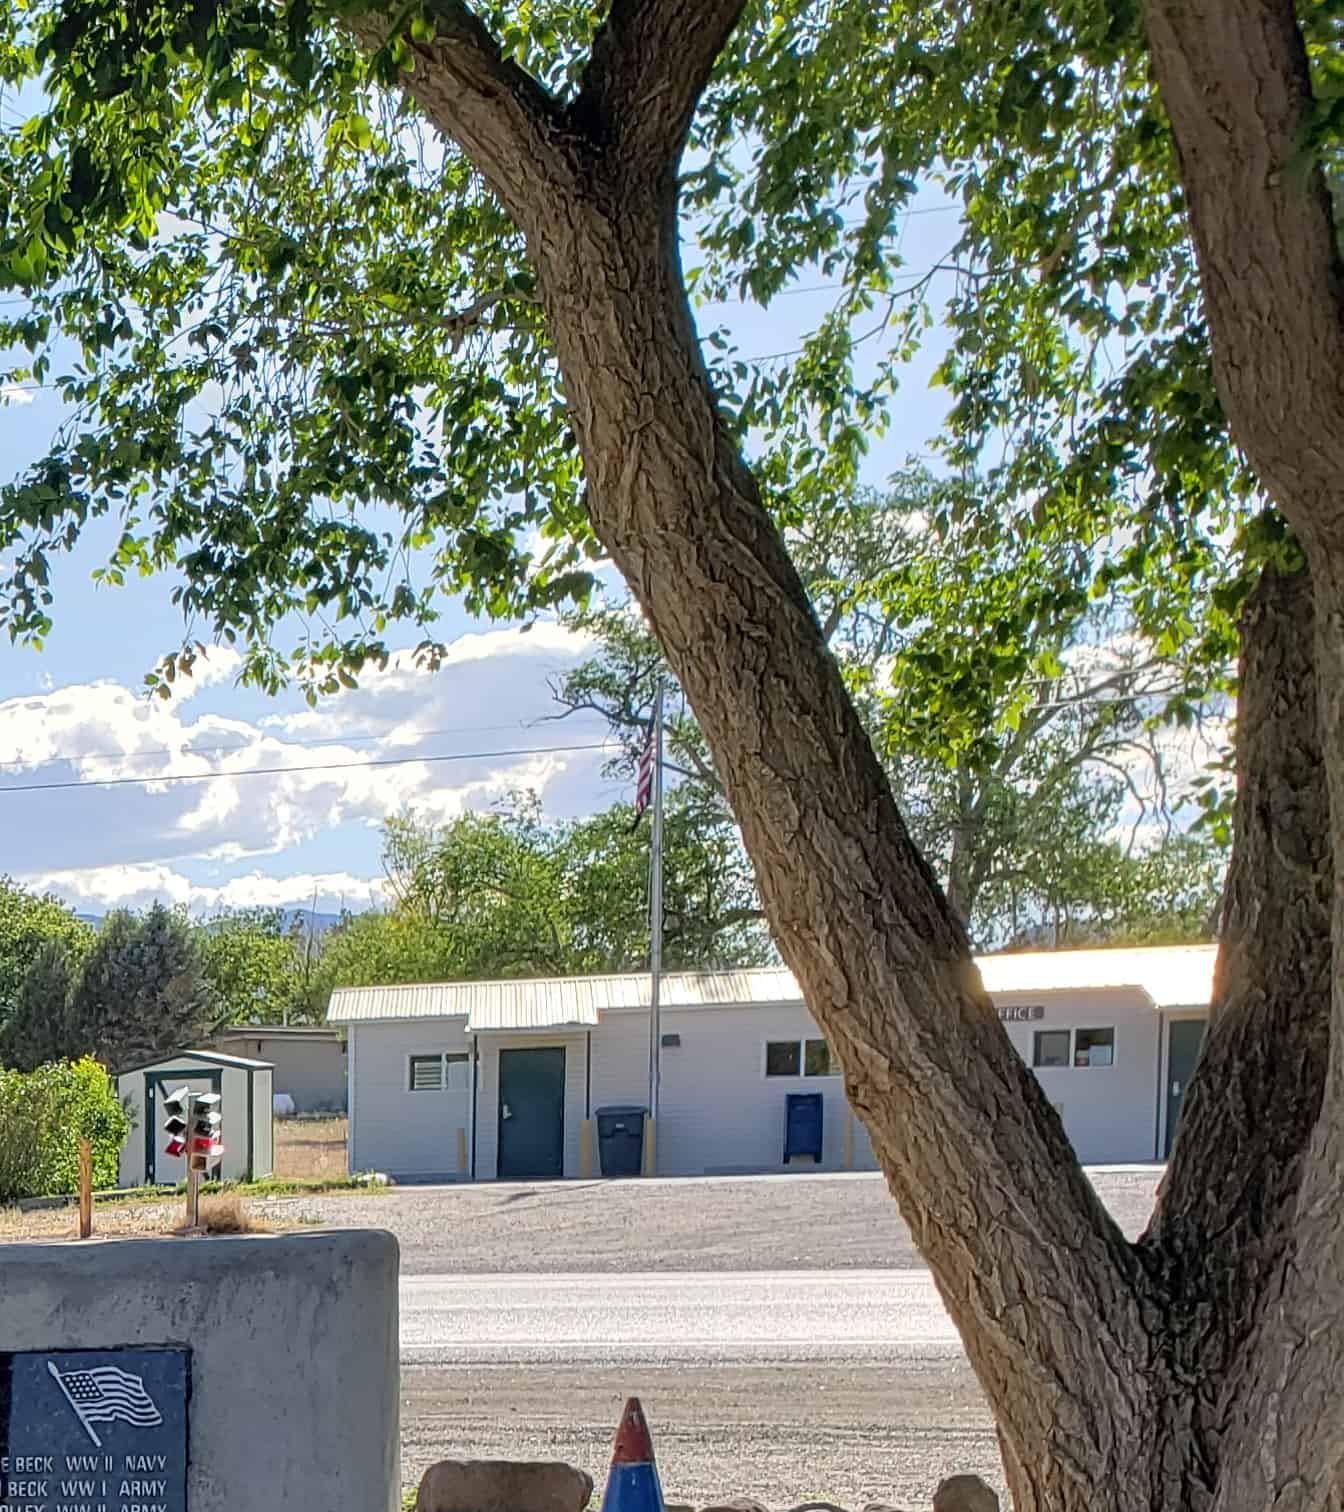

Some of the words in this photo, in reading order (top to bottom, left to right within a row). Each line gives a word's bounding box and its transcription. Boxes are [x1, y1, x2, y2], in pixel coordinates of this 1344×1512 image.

[15, 1456, 53, 1473] BECK
[65, 1456, 98, 1473] WW
[104, 1456, 113, 1473] II
[125, 1455, 166, 1472] NAVY
[8, 1481, 48, 1497] BECK
[61, 1480, 95, 1497] WW
[119, 1479, 166, 1497] ARMY
